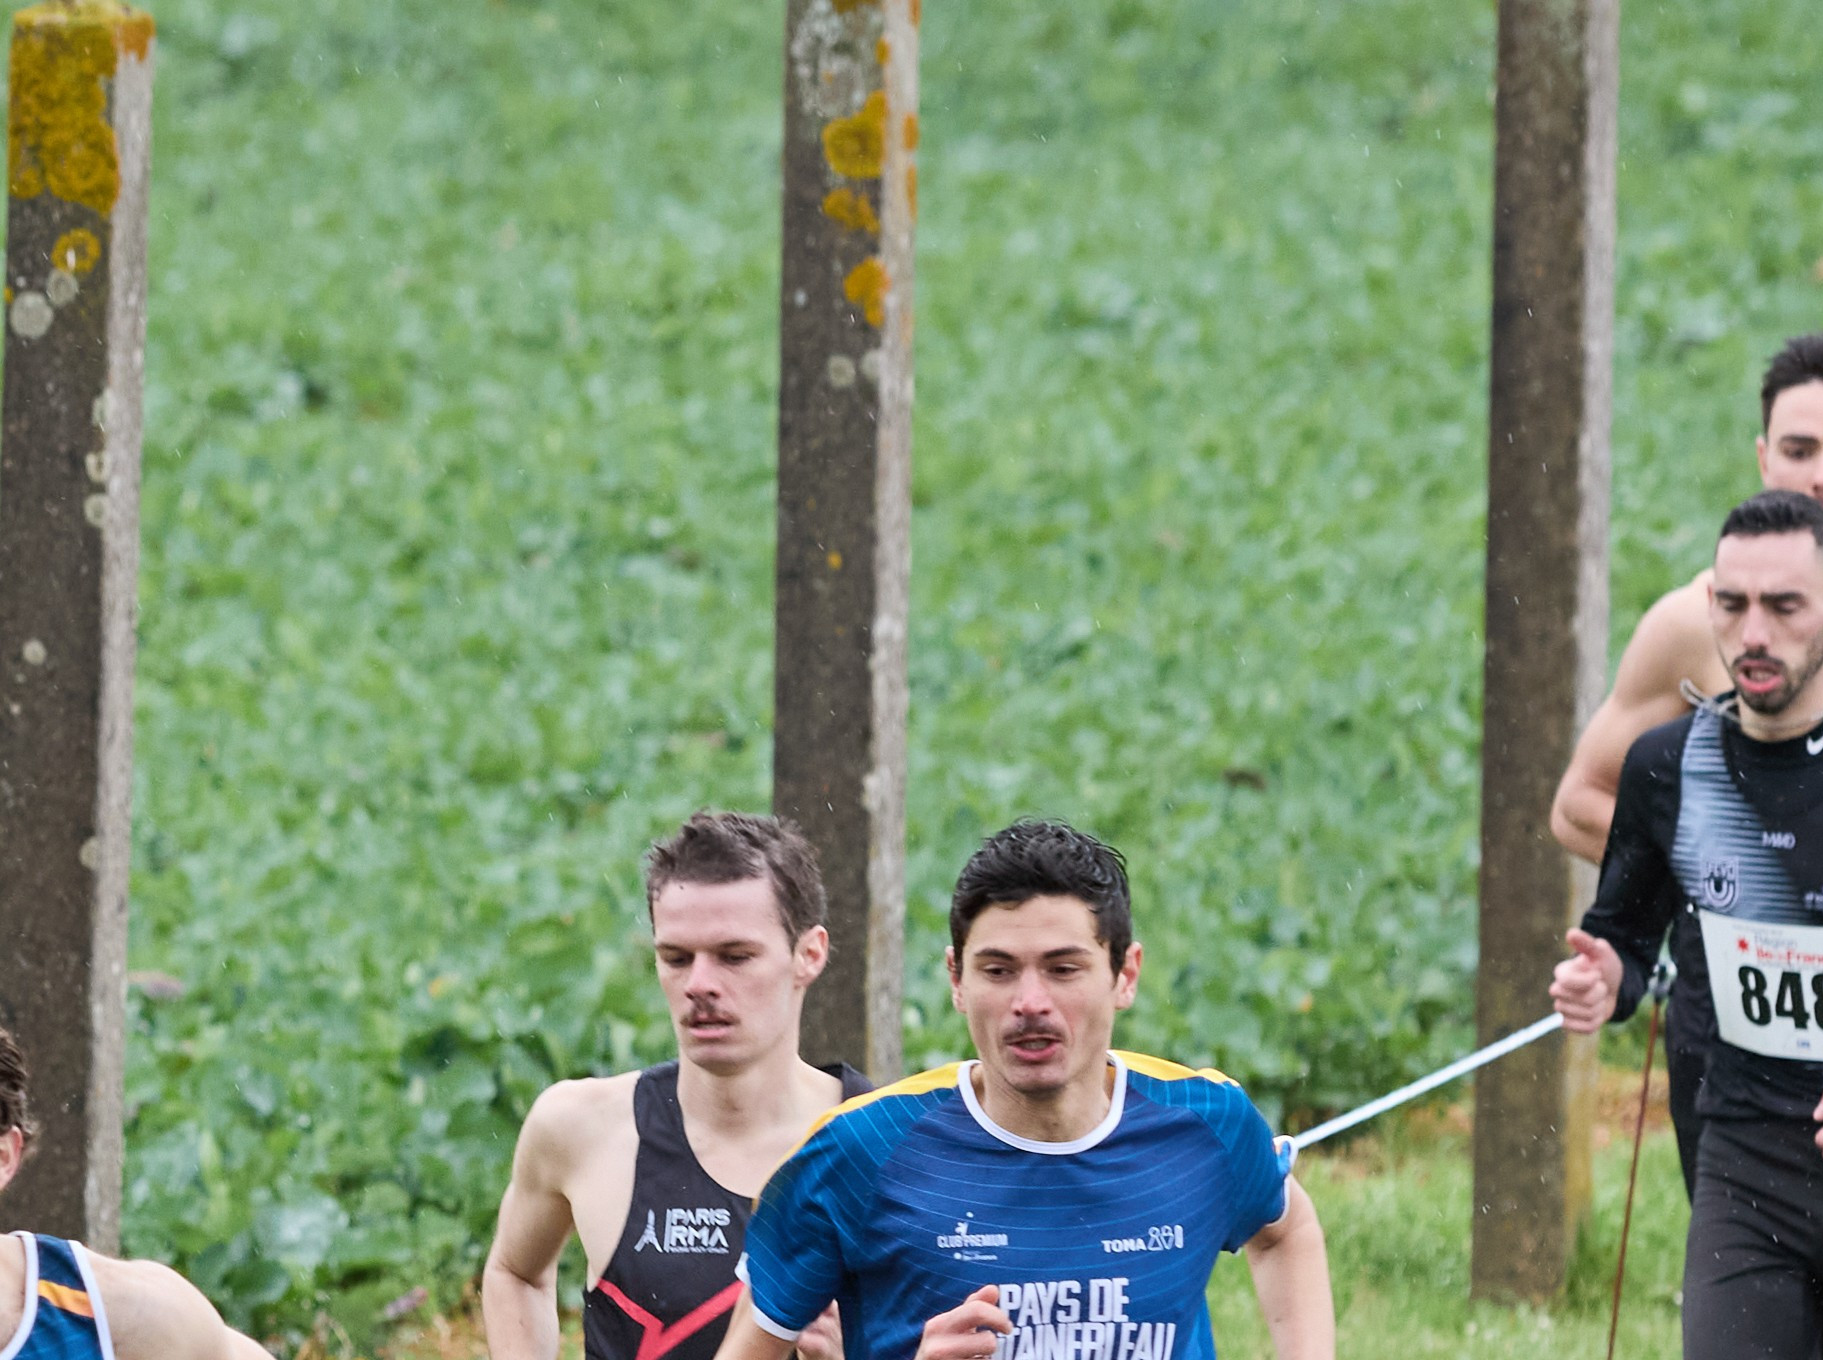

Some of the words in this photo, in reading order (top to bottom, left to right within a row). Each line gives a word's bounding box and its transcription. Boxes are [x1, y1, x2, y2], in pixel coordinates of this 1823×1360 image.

[671, 1208, 732, 1226] PARIS
[999, 1280, 1081, 1327] PAYS
[1089, 1277, 1130, 1323] DE
